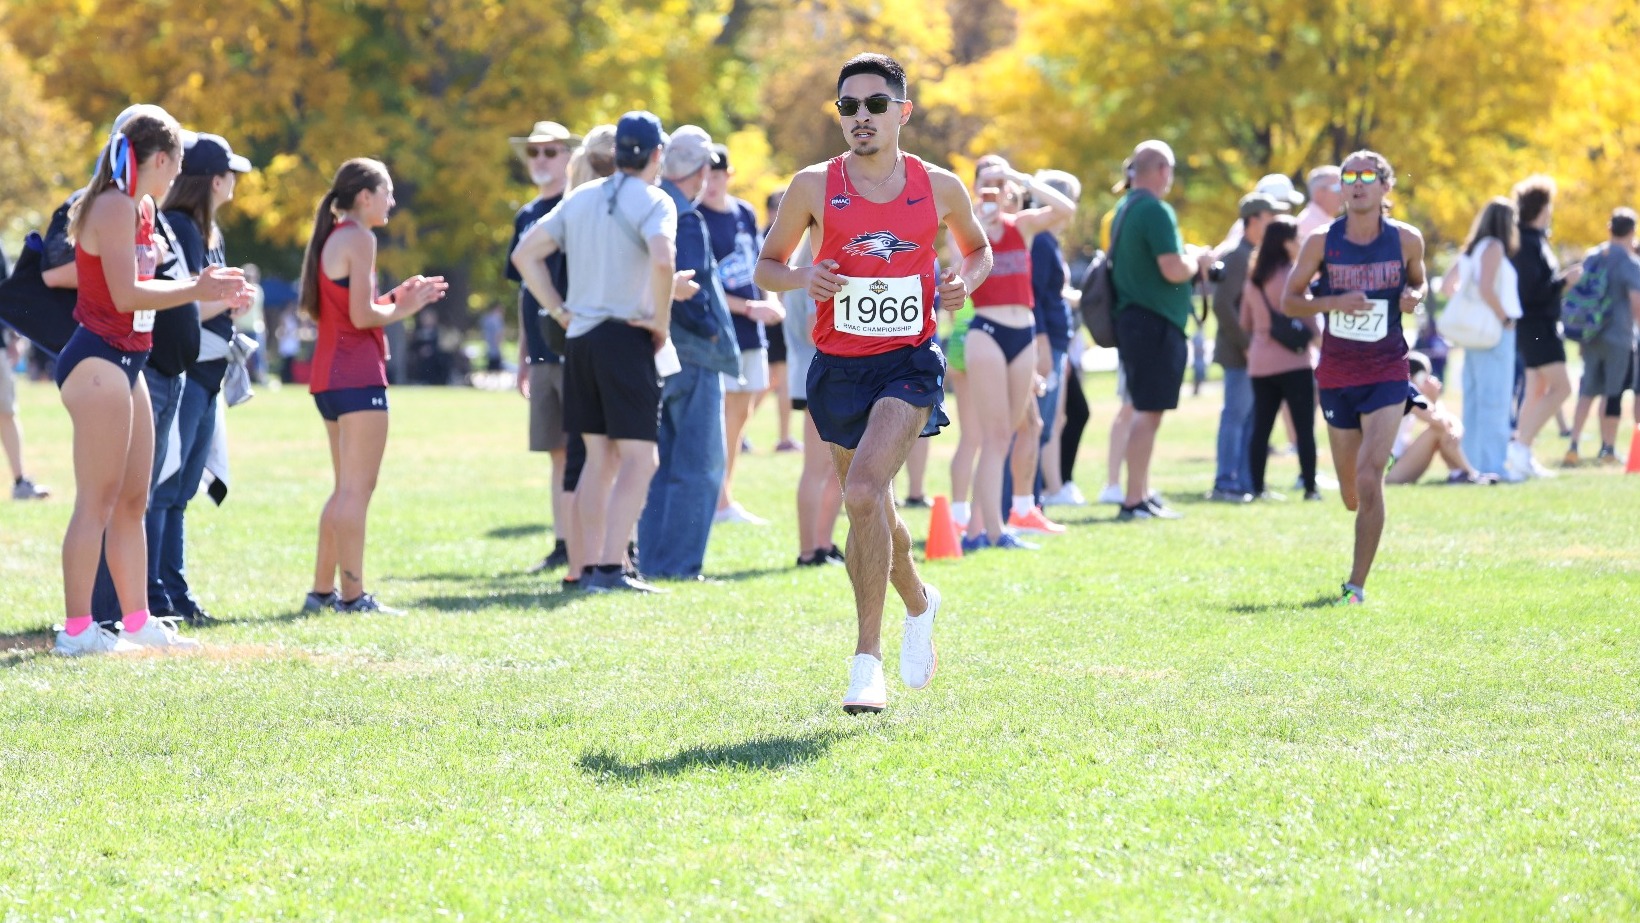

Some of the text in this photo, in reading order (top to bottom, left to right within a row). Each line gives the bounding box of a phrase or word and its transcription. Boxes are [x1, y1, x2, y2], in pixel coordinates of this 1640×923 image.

[840, 295, 919, 324] 1966
[843, 323, 912, 333] RMAC CHAMPIONSHIP
[1333, 310, 1384, 332] 1927
